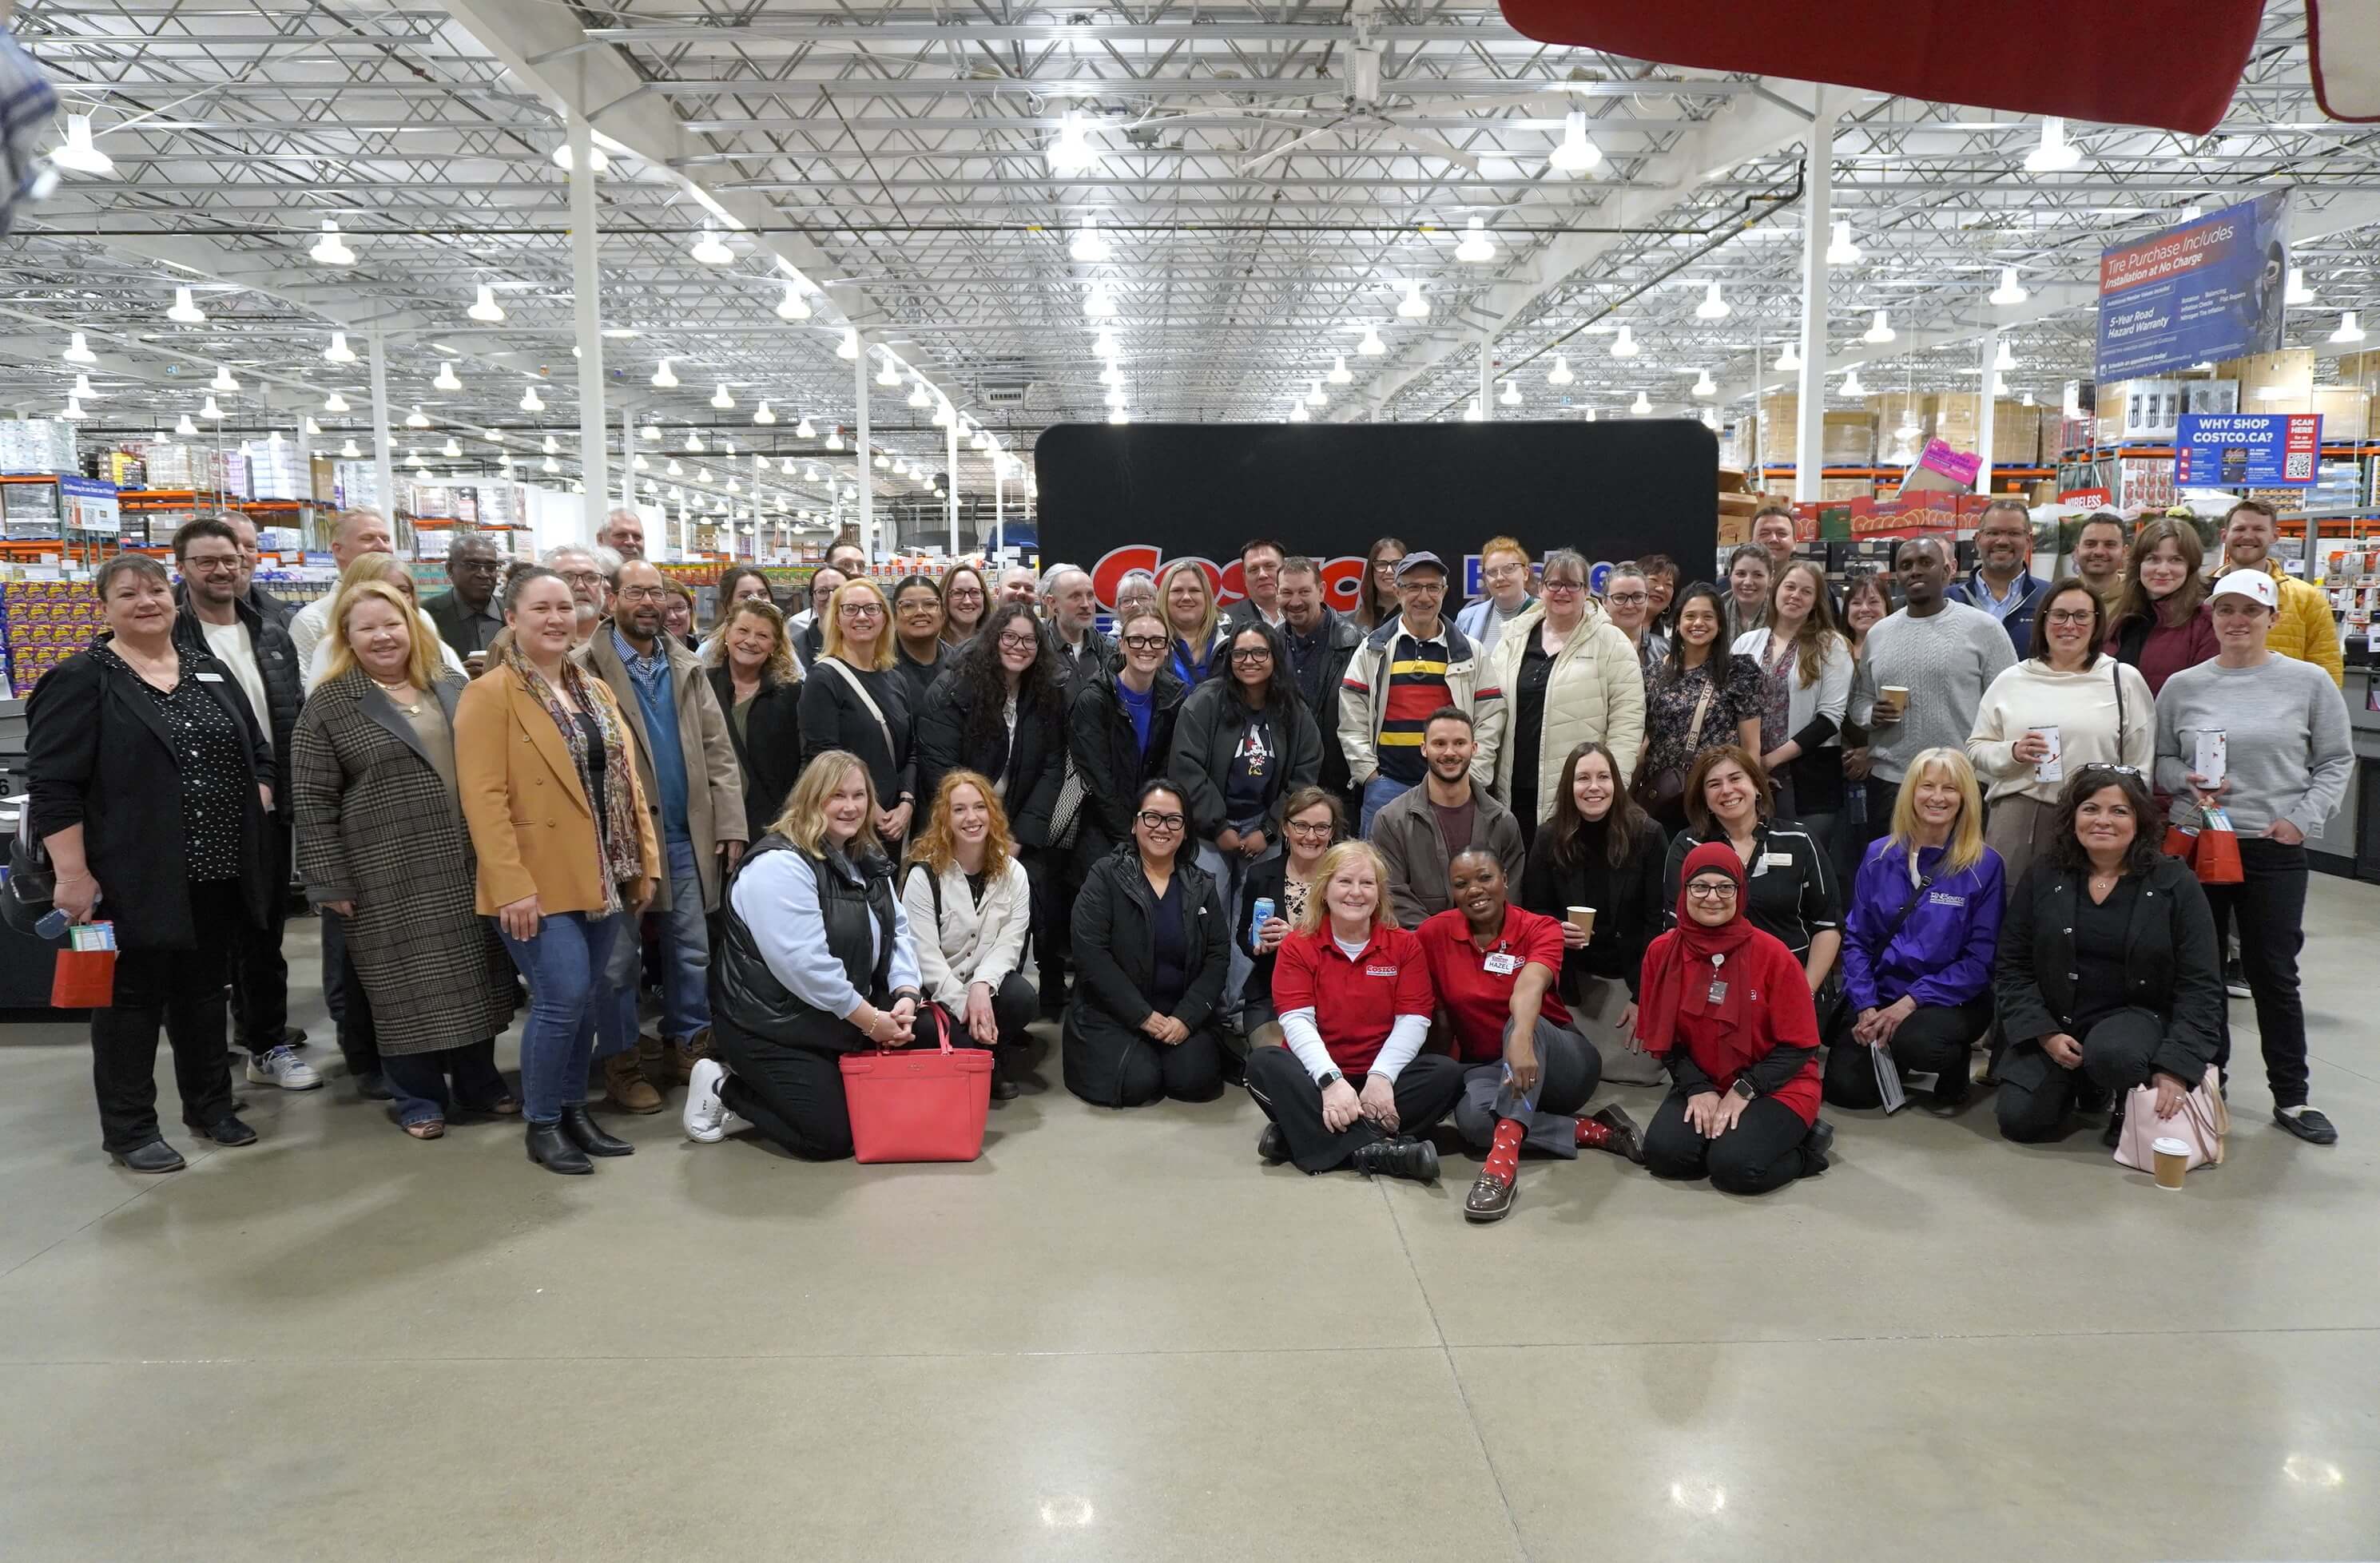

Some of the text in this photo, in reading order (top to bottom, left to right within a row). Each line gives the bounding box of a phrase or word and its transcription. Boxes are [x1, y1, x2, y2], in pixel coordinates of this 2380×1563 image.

[2108, 226, 2235, 276] Tire Purchase Includes
[2105, 252, 2203, 289] Installation at No Charge
[2109, 307, 2155, 327] 5-Year Road
[2108, 315, 2169, 339] Hazard Warranty
[2199, 419, 2270, 429] WHY SHOP
[2192, 432, 2274, 443] COSTCO.CA?
[2064, 495, 2102, 509] WIRELESS
[1488, 962, 1510, 970] HAZEL
